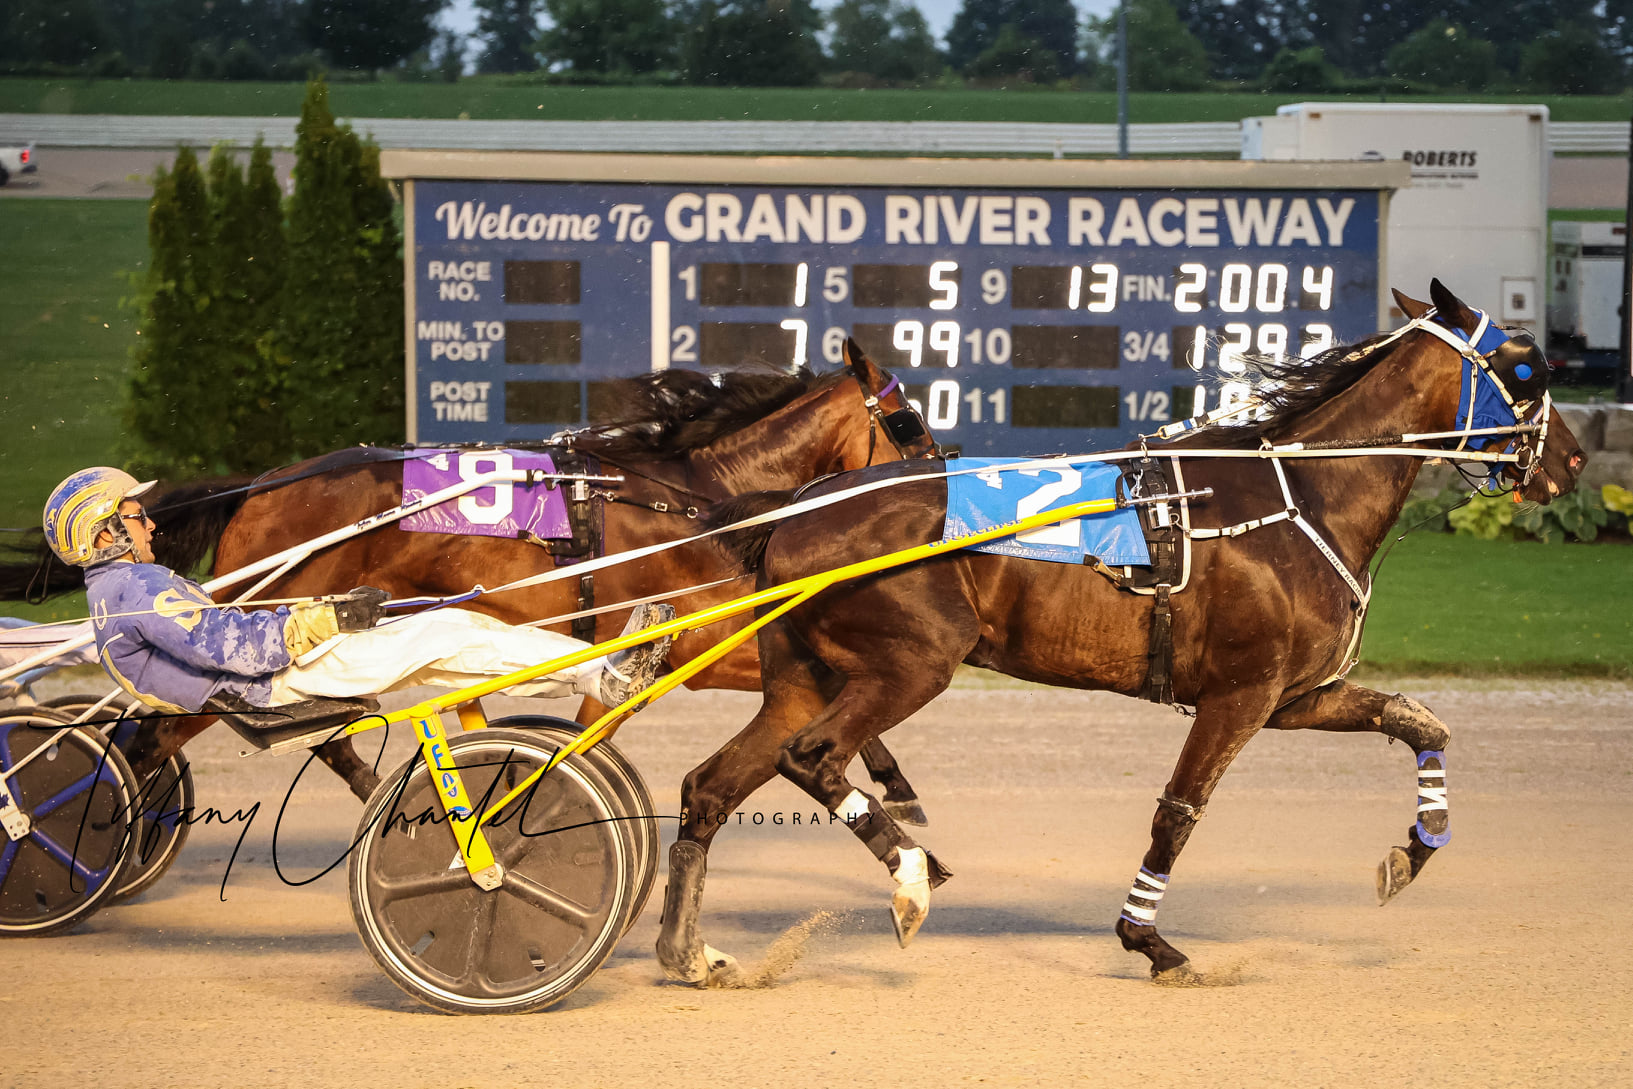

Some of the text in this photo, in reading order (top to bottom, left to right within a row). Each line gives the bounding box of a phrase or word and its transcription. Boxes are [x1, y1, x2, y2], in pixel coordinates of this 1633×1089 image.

[1403, 151, 1477, 167] ROBERTS
[435, 193, 1355, 248] Welcome To GRAND RIVER RACEWAY
[428, 261, 491, 281] RACE
[678, 266, 696, 300] 1
[794, 262, 808, 307] 1
[823, 266, 849, 303] 5
[929, 261, 959, 310] 5
[981, 268, 1006, 305] 9
[1068, 263, 1119, 312] 13
[1123, 276, 1171, 302] FIN.
[439, 282, 480, 302] NO.
[418, 321, 505, 342] MIN. TO
[671, 327, 697, 362] 2
[780, 319, 808, 366] 7
[822, 327, 847, 364] 6
[893, 320, 961, 368] 99
[965, 327, 1012, 365] 10
[1123, 332, 1171, 363] 3/4
[431, 342, 491, 361] POST
[430, 382, 491, 402] POST
[964, 388, 1006, 424] 11
[1129, 391, 1170, 422] 1/2
[433, 402, 488, 422] TIME
[458, 451, 513, 525] 9
[1015, 460, 1082, 547] 2
